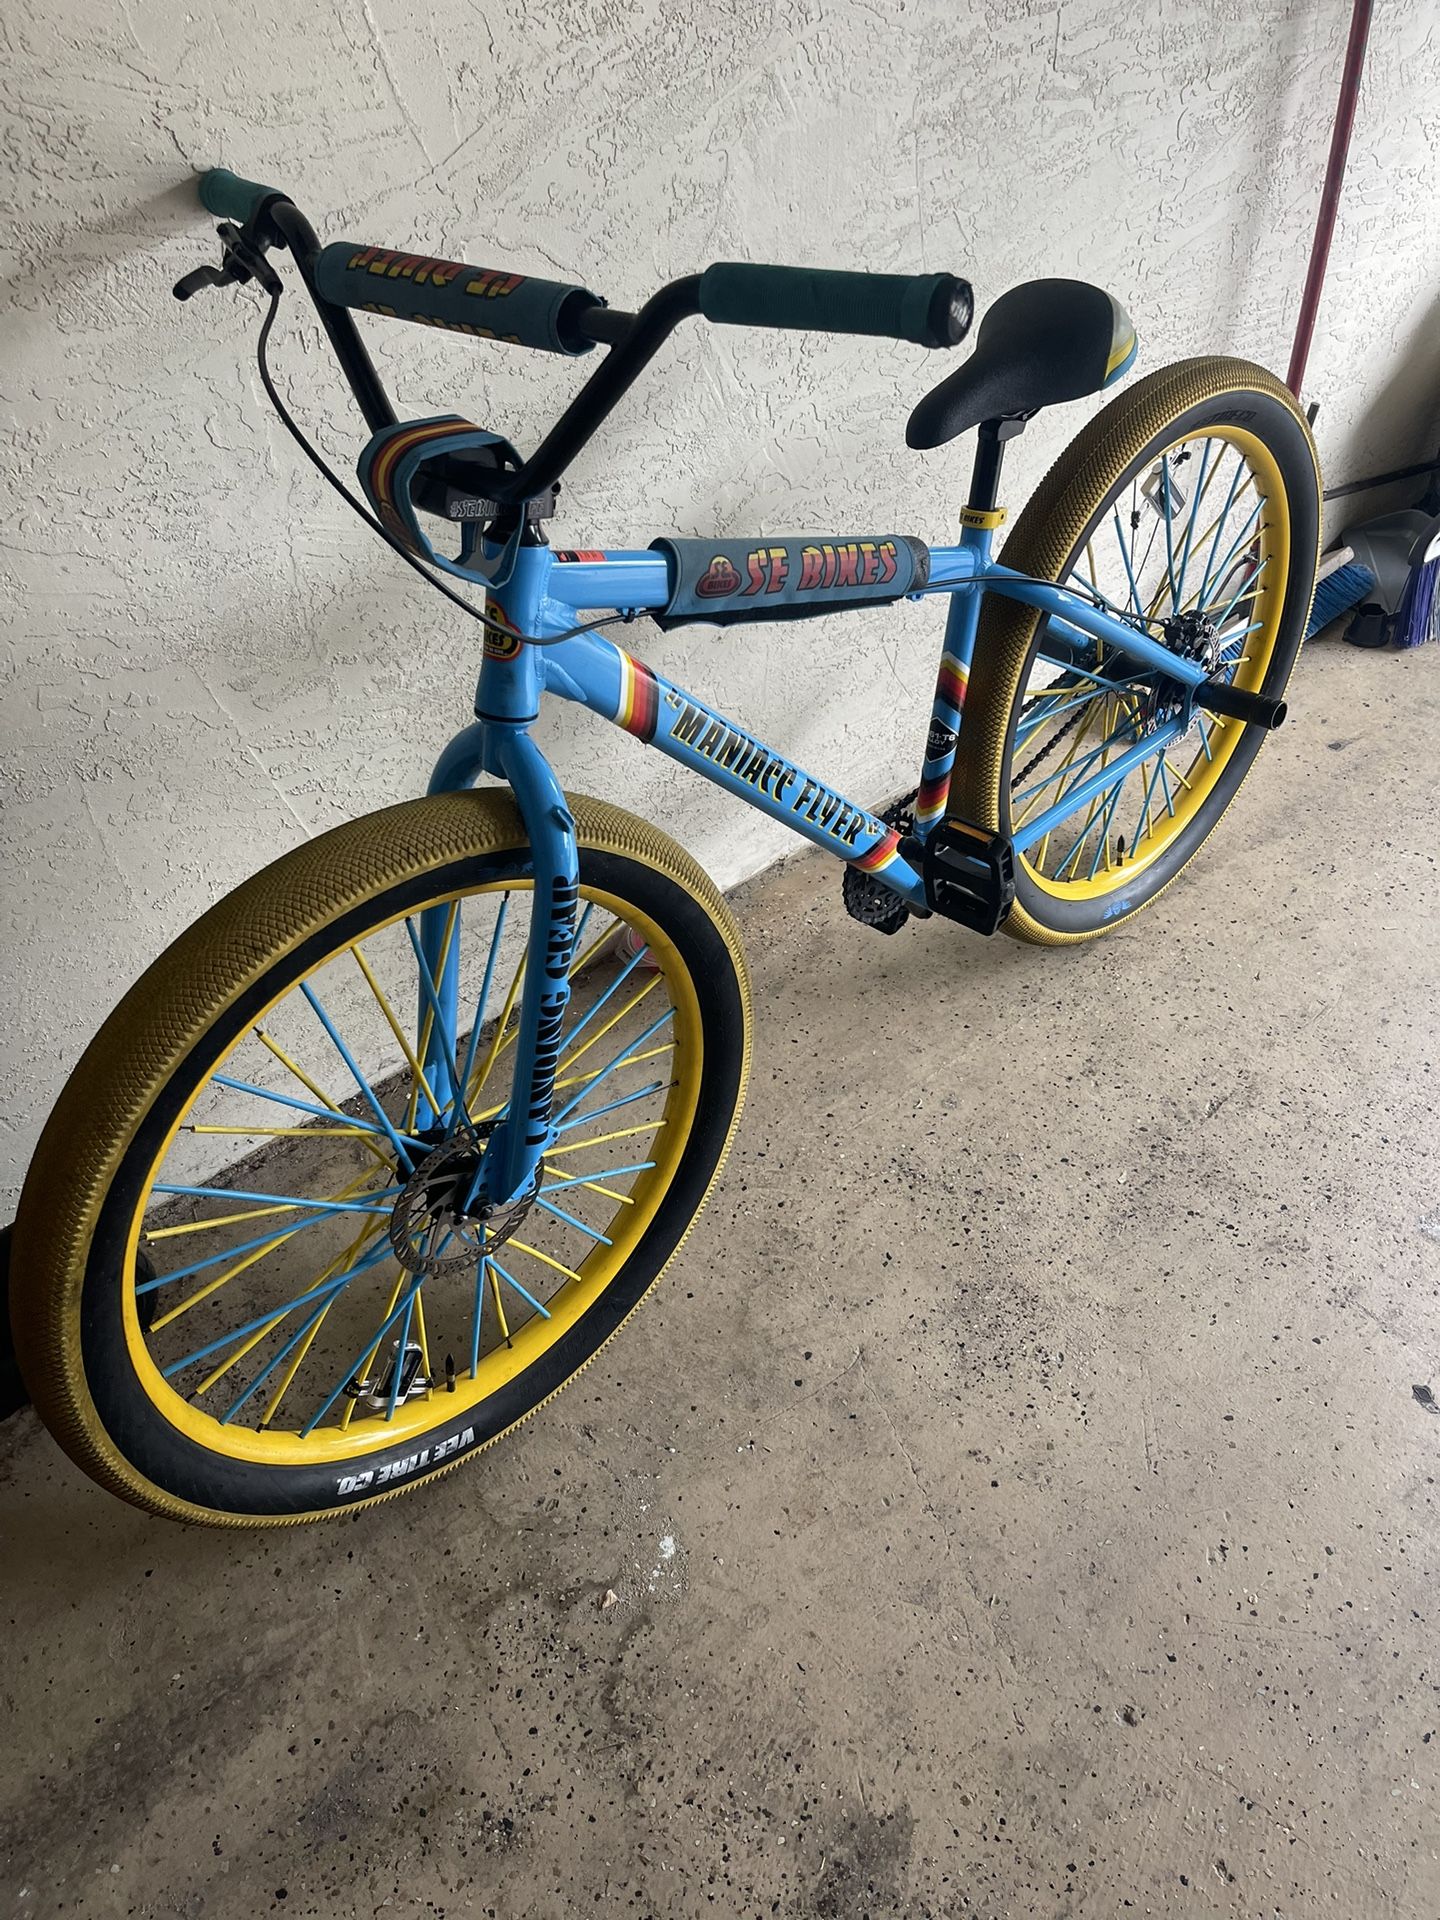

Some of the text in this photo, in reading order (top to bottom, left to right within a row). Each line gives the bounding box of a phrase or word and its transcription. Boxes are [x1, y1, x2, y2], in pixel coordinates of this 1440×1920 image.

[738, 541, 898, 597] SE BIKES
[545, 874, 578, 980] GEAR
[336, 1426, 475, 1496] VEE TIRE CO.
